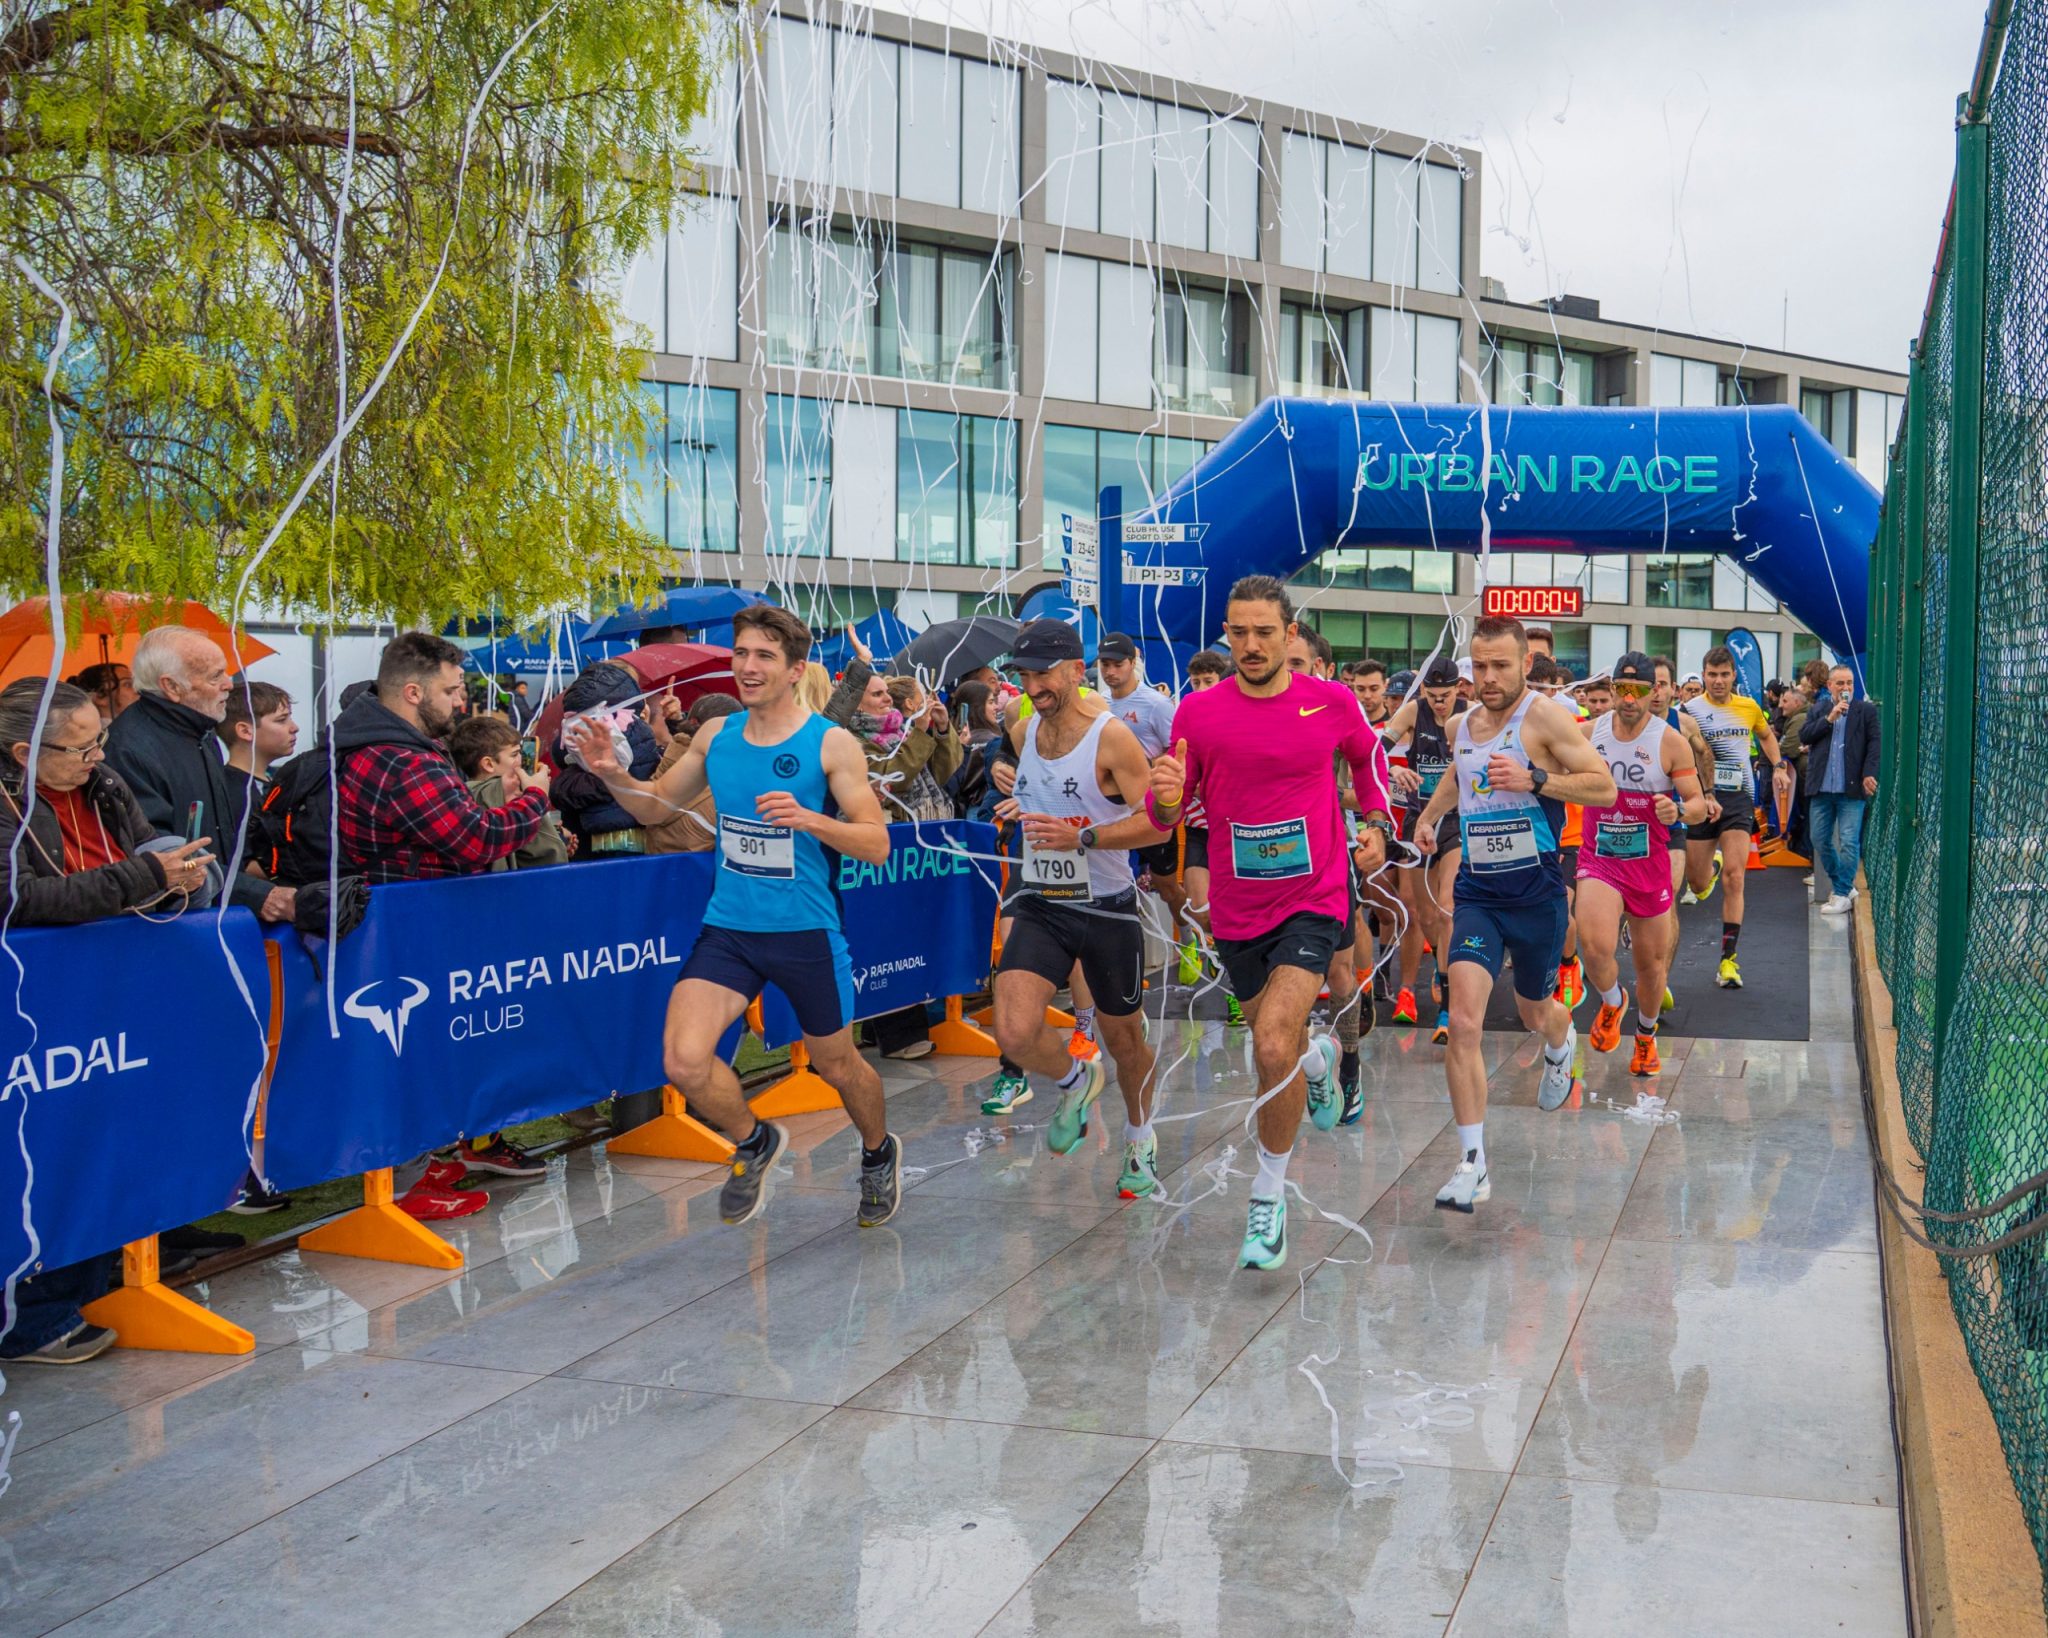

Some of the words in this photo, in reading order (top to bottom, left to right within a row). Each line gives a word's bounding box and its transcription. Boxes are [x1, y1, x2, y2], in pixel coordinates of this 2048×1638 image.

[1361, 453, 1557, 493] URBAN
[1571, 455, 1719, 493] RACE
[1488, 589, 1577, 613] 00:00:04
[1604, 760, 1645, 783] ne
[1393, 784, 1406, 796] 86
[740, 837, 766, 856] 901
[1258, 842, 1279, 859] 95
[1487, 836, 1513, 852] 554
[1612, 835, 1633, 847] 252
[902, 841, 971, 881] RACE
[1033, 858, 1076, 879] 1790
[449, 956, 552, 1004] RAFA
[562, 936, 681, 982] NADAL
[870, 961, 894, 978] RAFA
[895, 955, 926, 972] NADAL
[870, 978, 888, 991] CLUB
[450, 1003, 524, 1041] CLUB
[0, 1032, 149, 1101] ADAL
